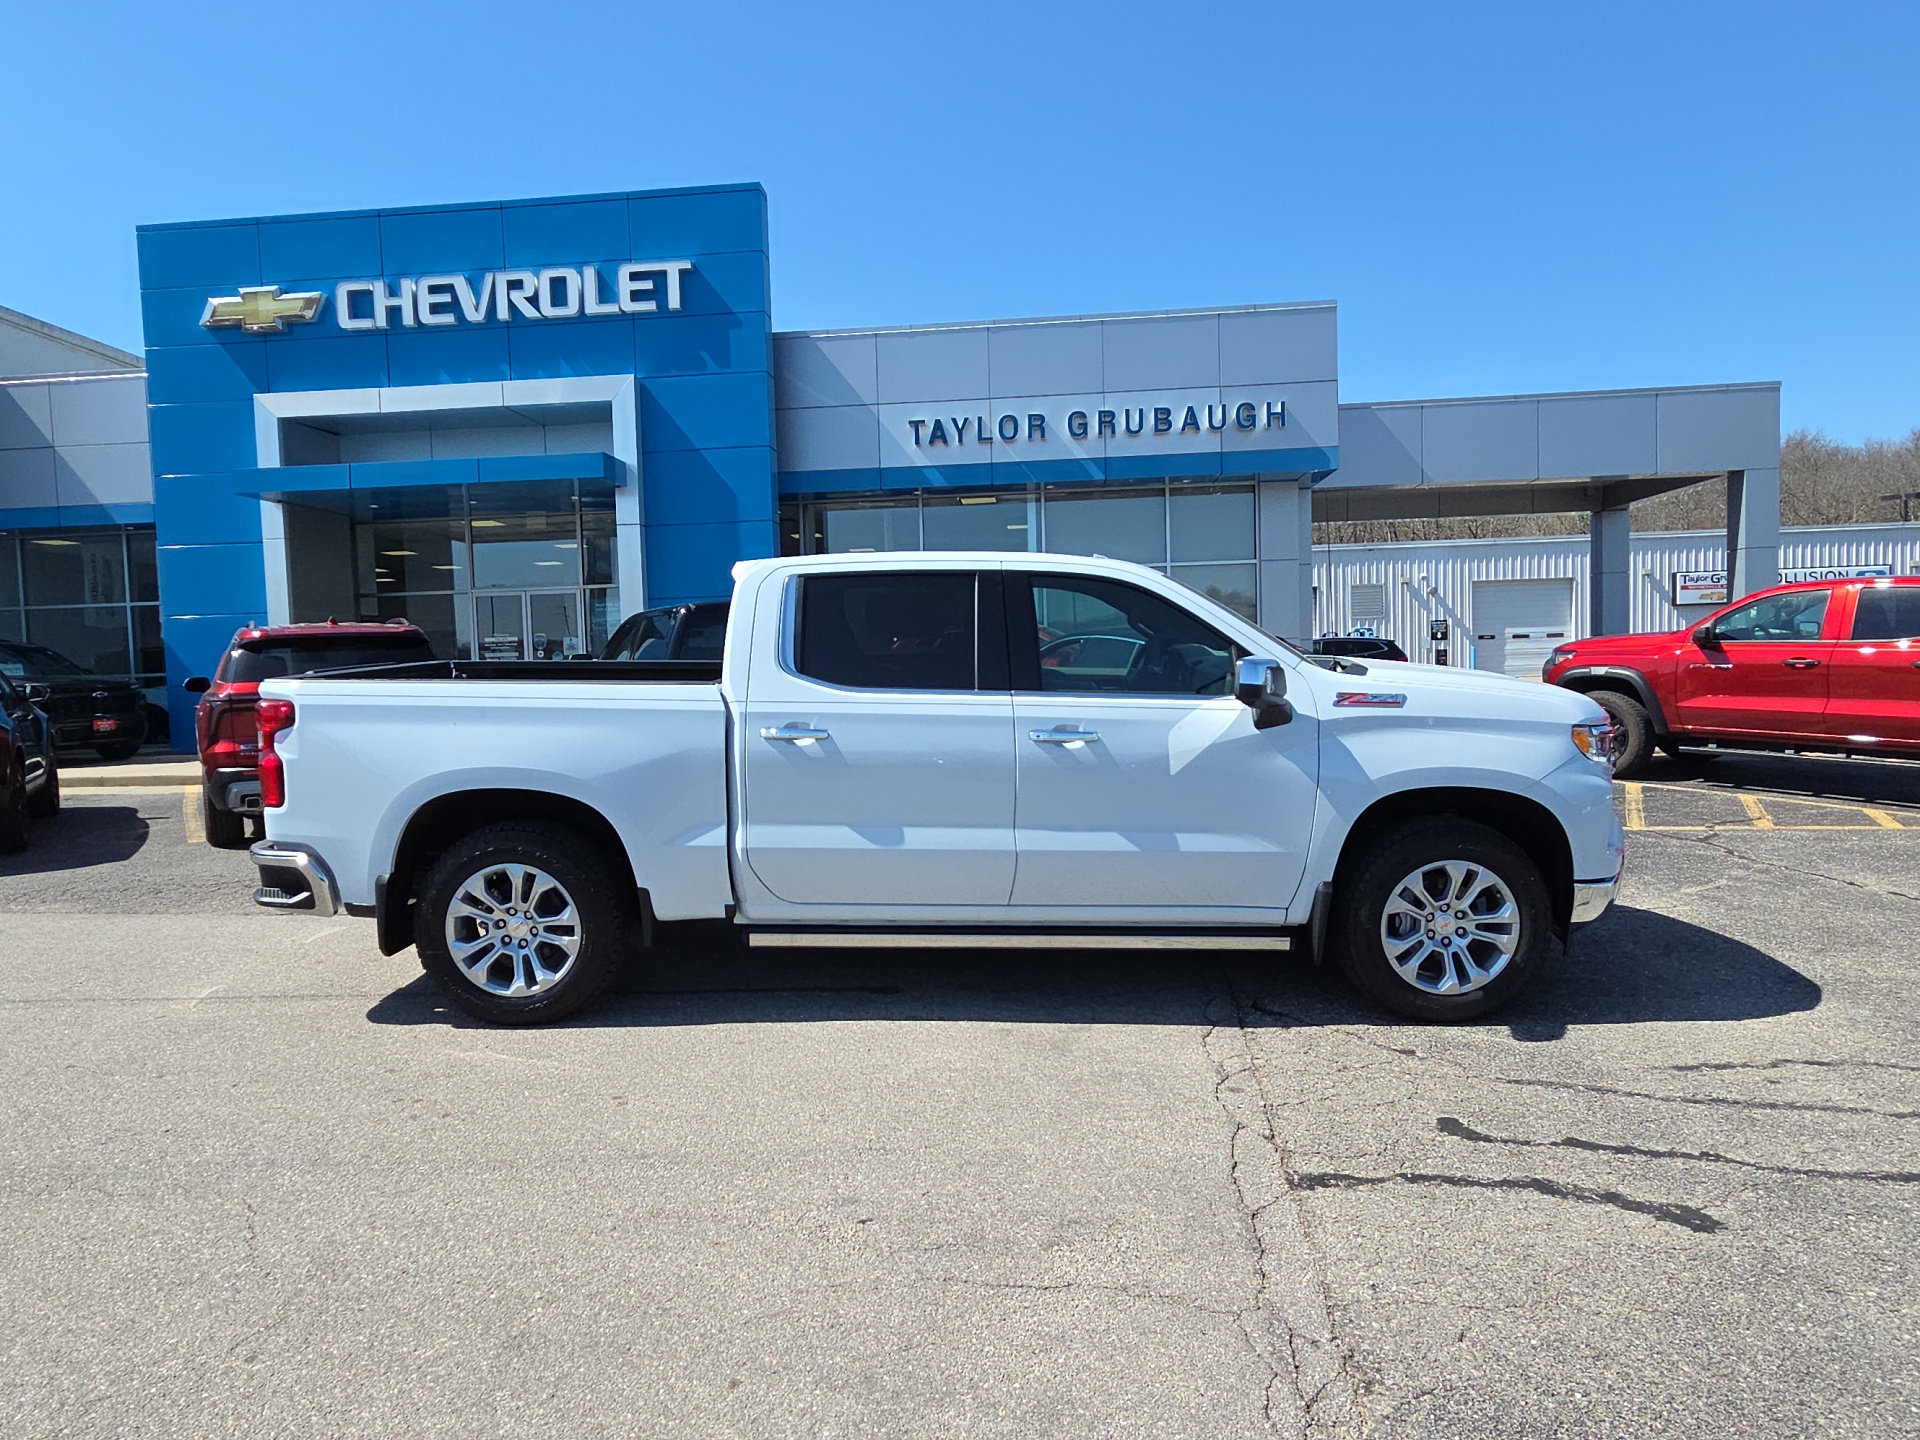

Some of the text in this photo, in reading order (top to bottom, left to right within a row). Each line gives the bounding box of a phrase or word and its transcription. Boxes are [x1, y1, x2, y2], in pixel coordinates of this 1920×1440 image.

[336, 259, 693, 331] CHEVROLET
[908, 400, 1287, 447] TAYLOR GRUBAUGH
[1680, 574, 1709, 585] Taylor
